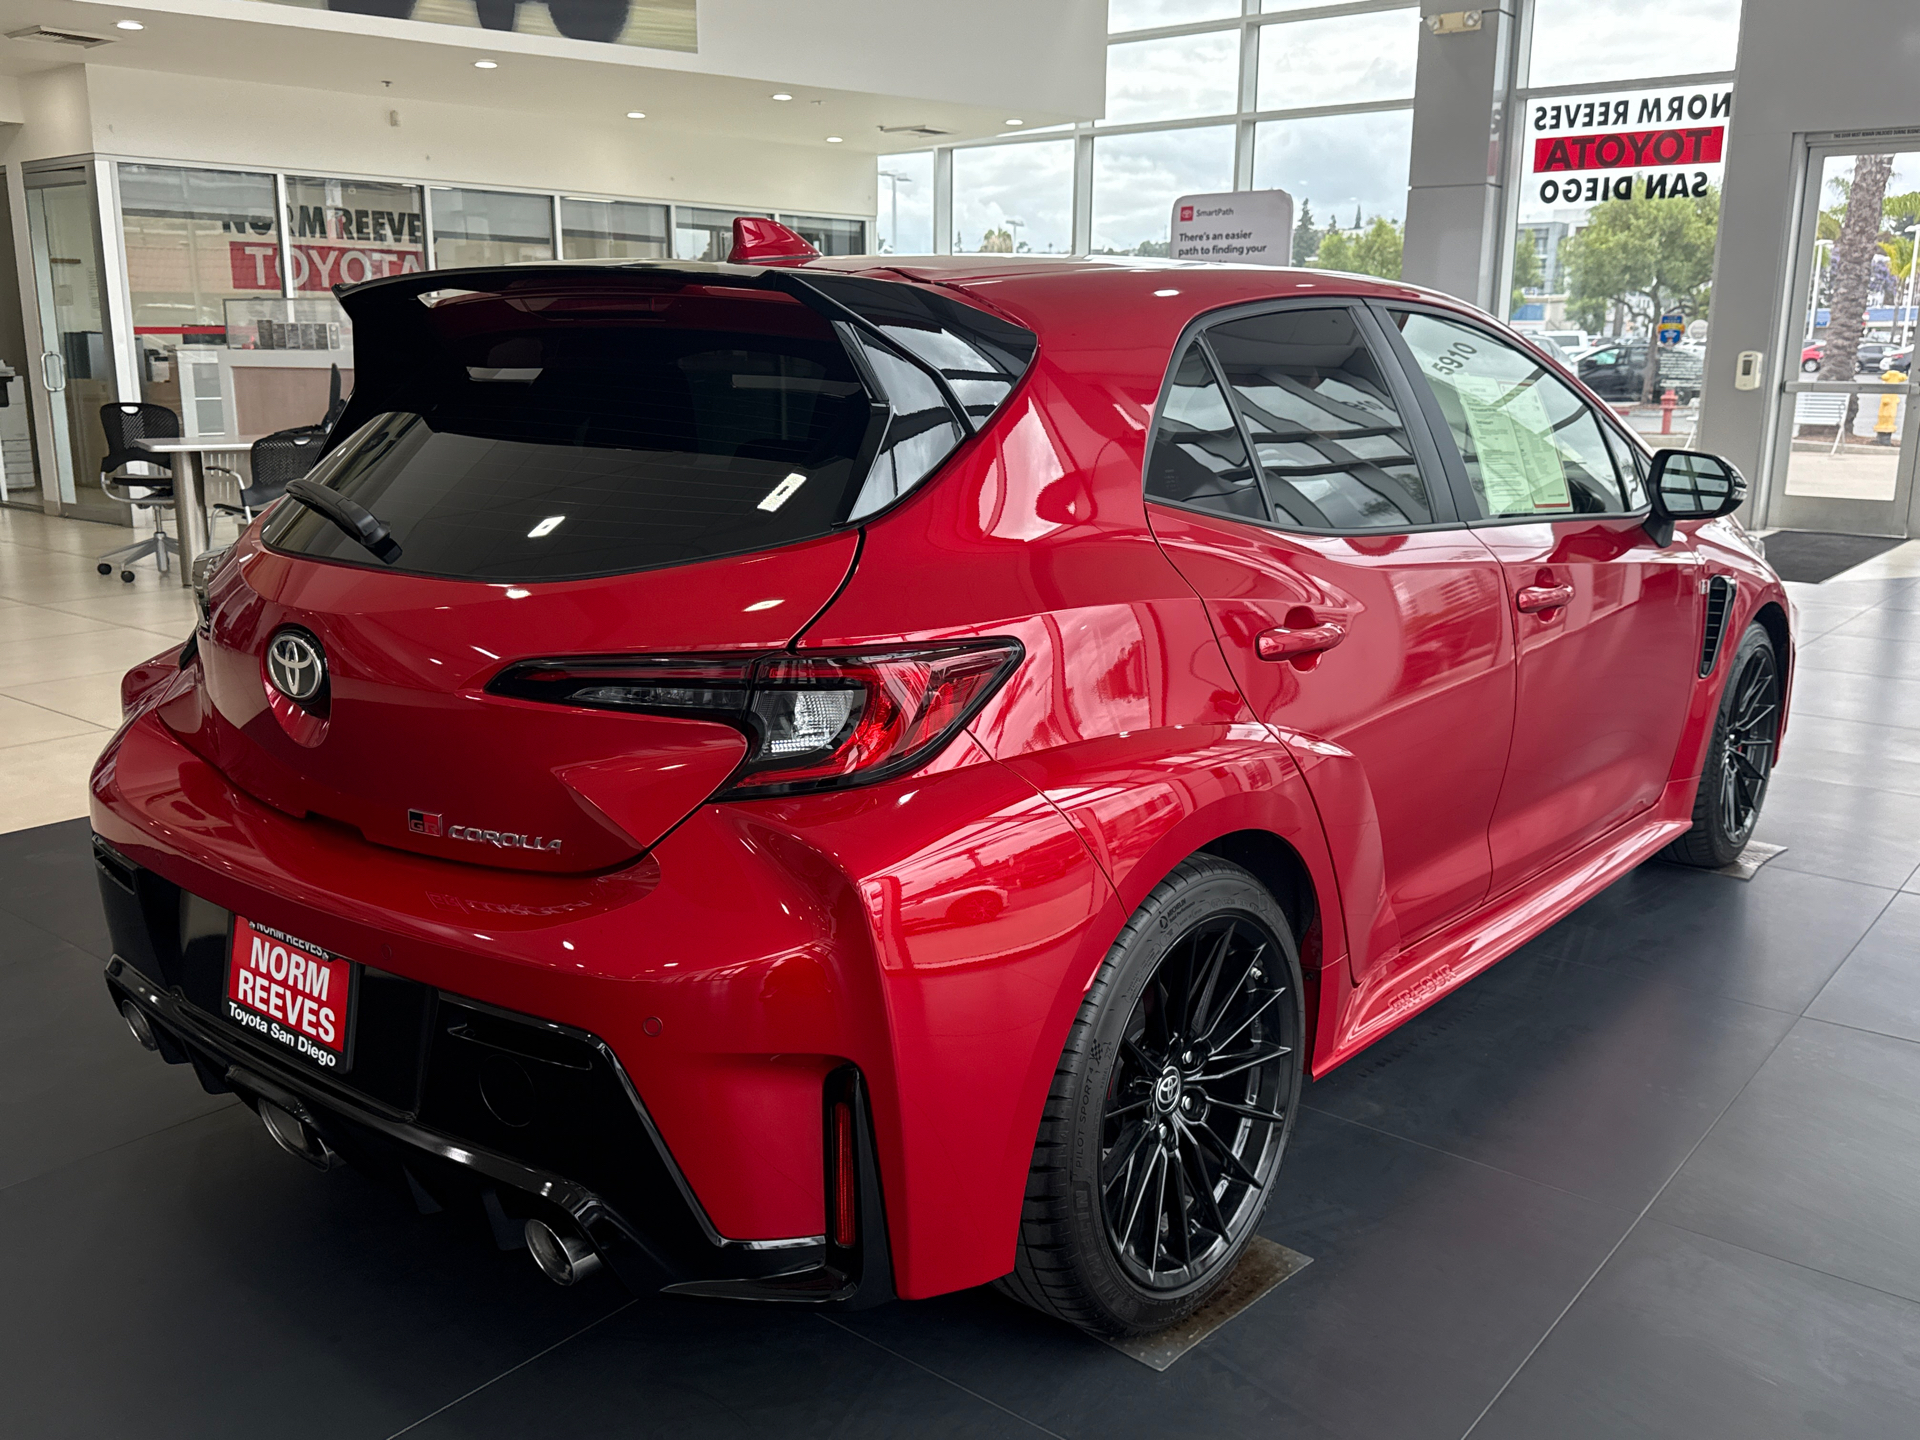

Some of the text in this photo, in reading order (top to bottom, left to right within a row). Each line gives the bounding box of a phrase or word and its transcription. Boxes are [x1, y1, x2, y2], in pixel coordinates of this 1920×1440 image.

[1196, 207, 1235, 218] SmartPath
[1178, 243, 1267, 258] path to finding your
[1179, 229, 1253, 243] There's an easier
[1432, 342, 1477, 376] 5910
[411, 819, 563, 855] GR COROLLA
[250, 936, 331, 1002] NORM
[237, 968, 336, 1043] REEVES
[228, 1001, 336, 1068] Toyota San Diego
[1079, 1077, 1093, 1124] SPORT
[1075, 1130, 1085, 1169] PILOT
